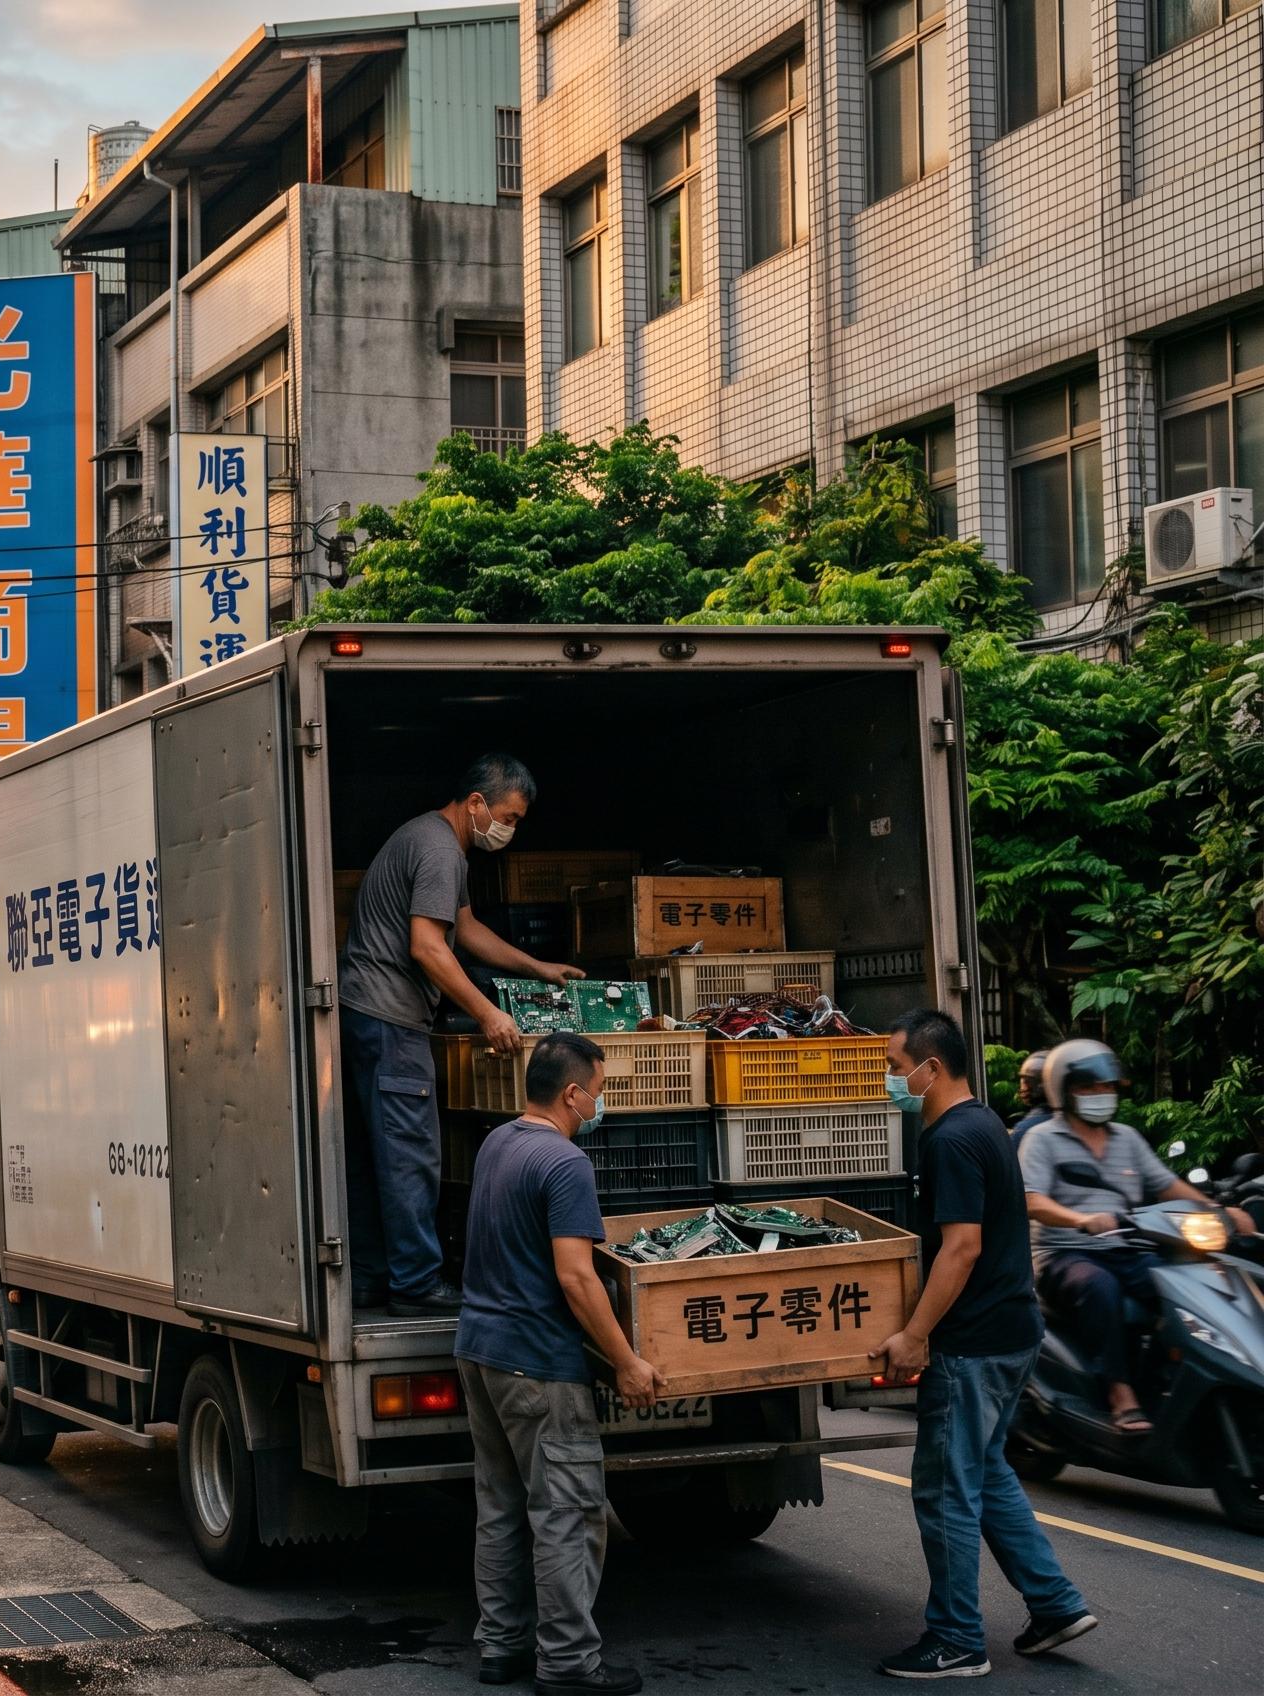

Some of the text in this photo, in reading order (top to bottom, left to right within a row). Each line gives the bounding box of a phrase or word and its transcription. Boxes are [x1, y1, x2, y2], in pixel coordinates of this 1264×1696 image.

[659, 902, 757, 927] 電子零件
[683, 1281, 871, 1344] 電子零件
